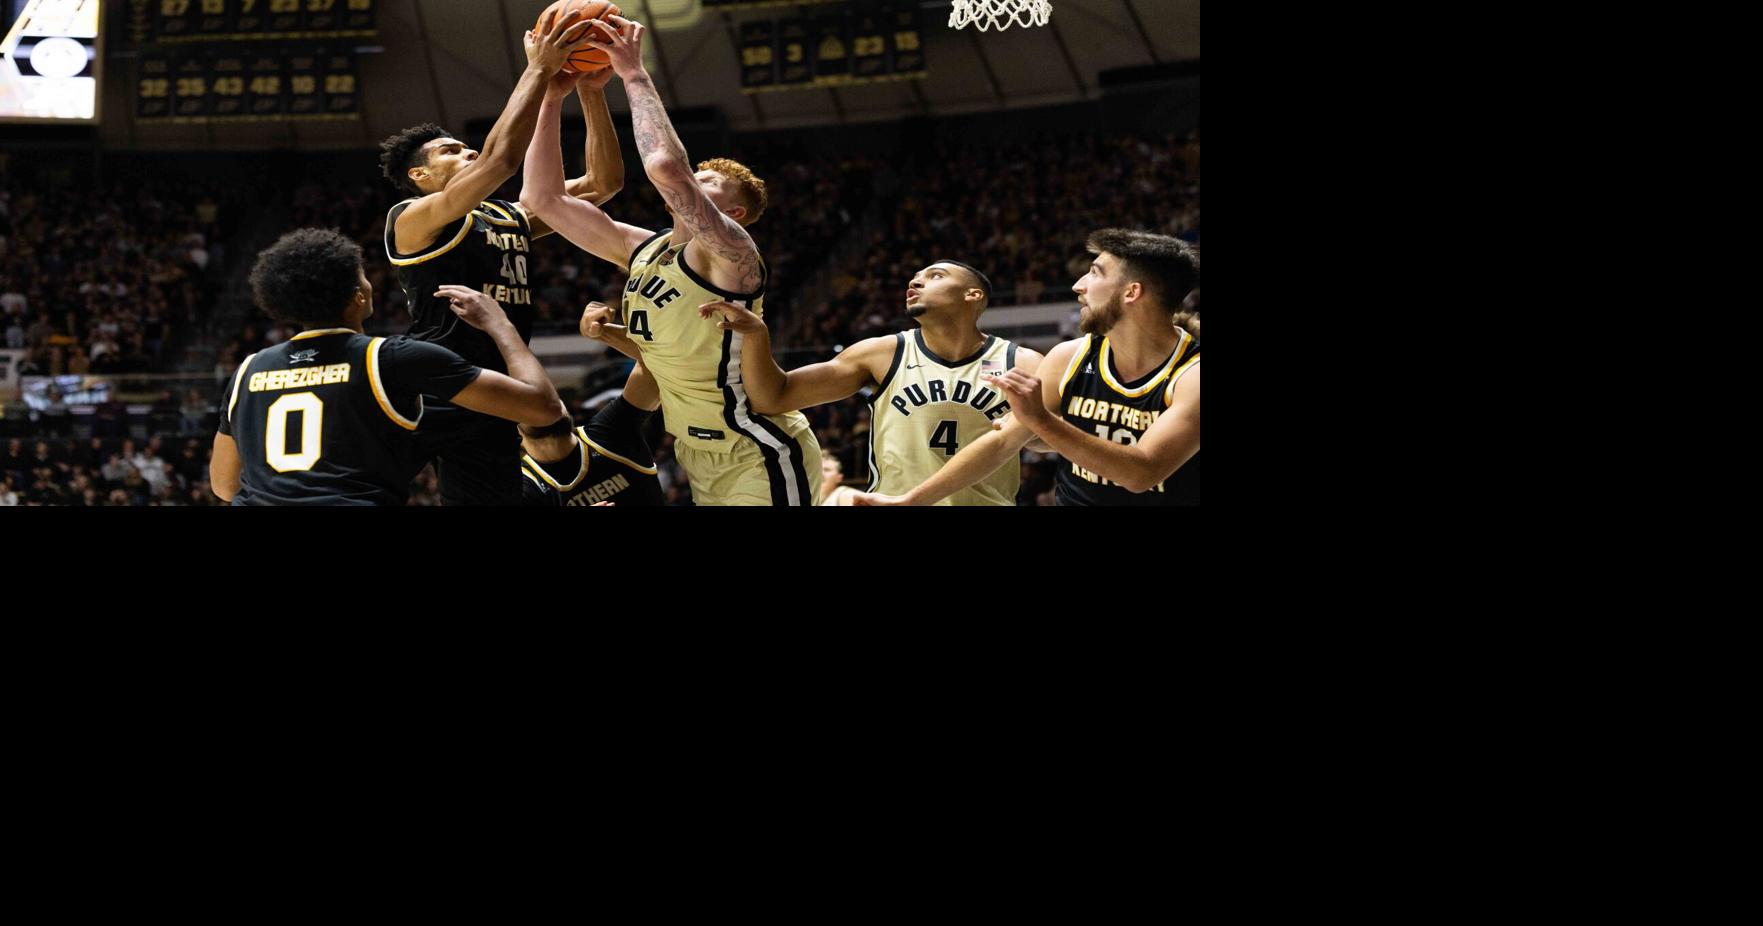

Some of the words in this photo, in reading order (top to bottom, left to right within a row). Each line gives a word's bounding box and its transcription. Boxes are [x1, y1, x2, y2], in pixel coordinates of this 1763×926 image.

[500, 253, 528, 285] 40
[248, 363, 351, 392] GHEREZGHER
[890, 379, 1012, 422] PURDUE
[265, 391, 324, 473] 0
[929, 420, 959, 456] 4
